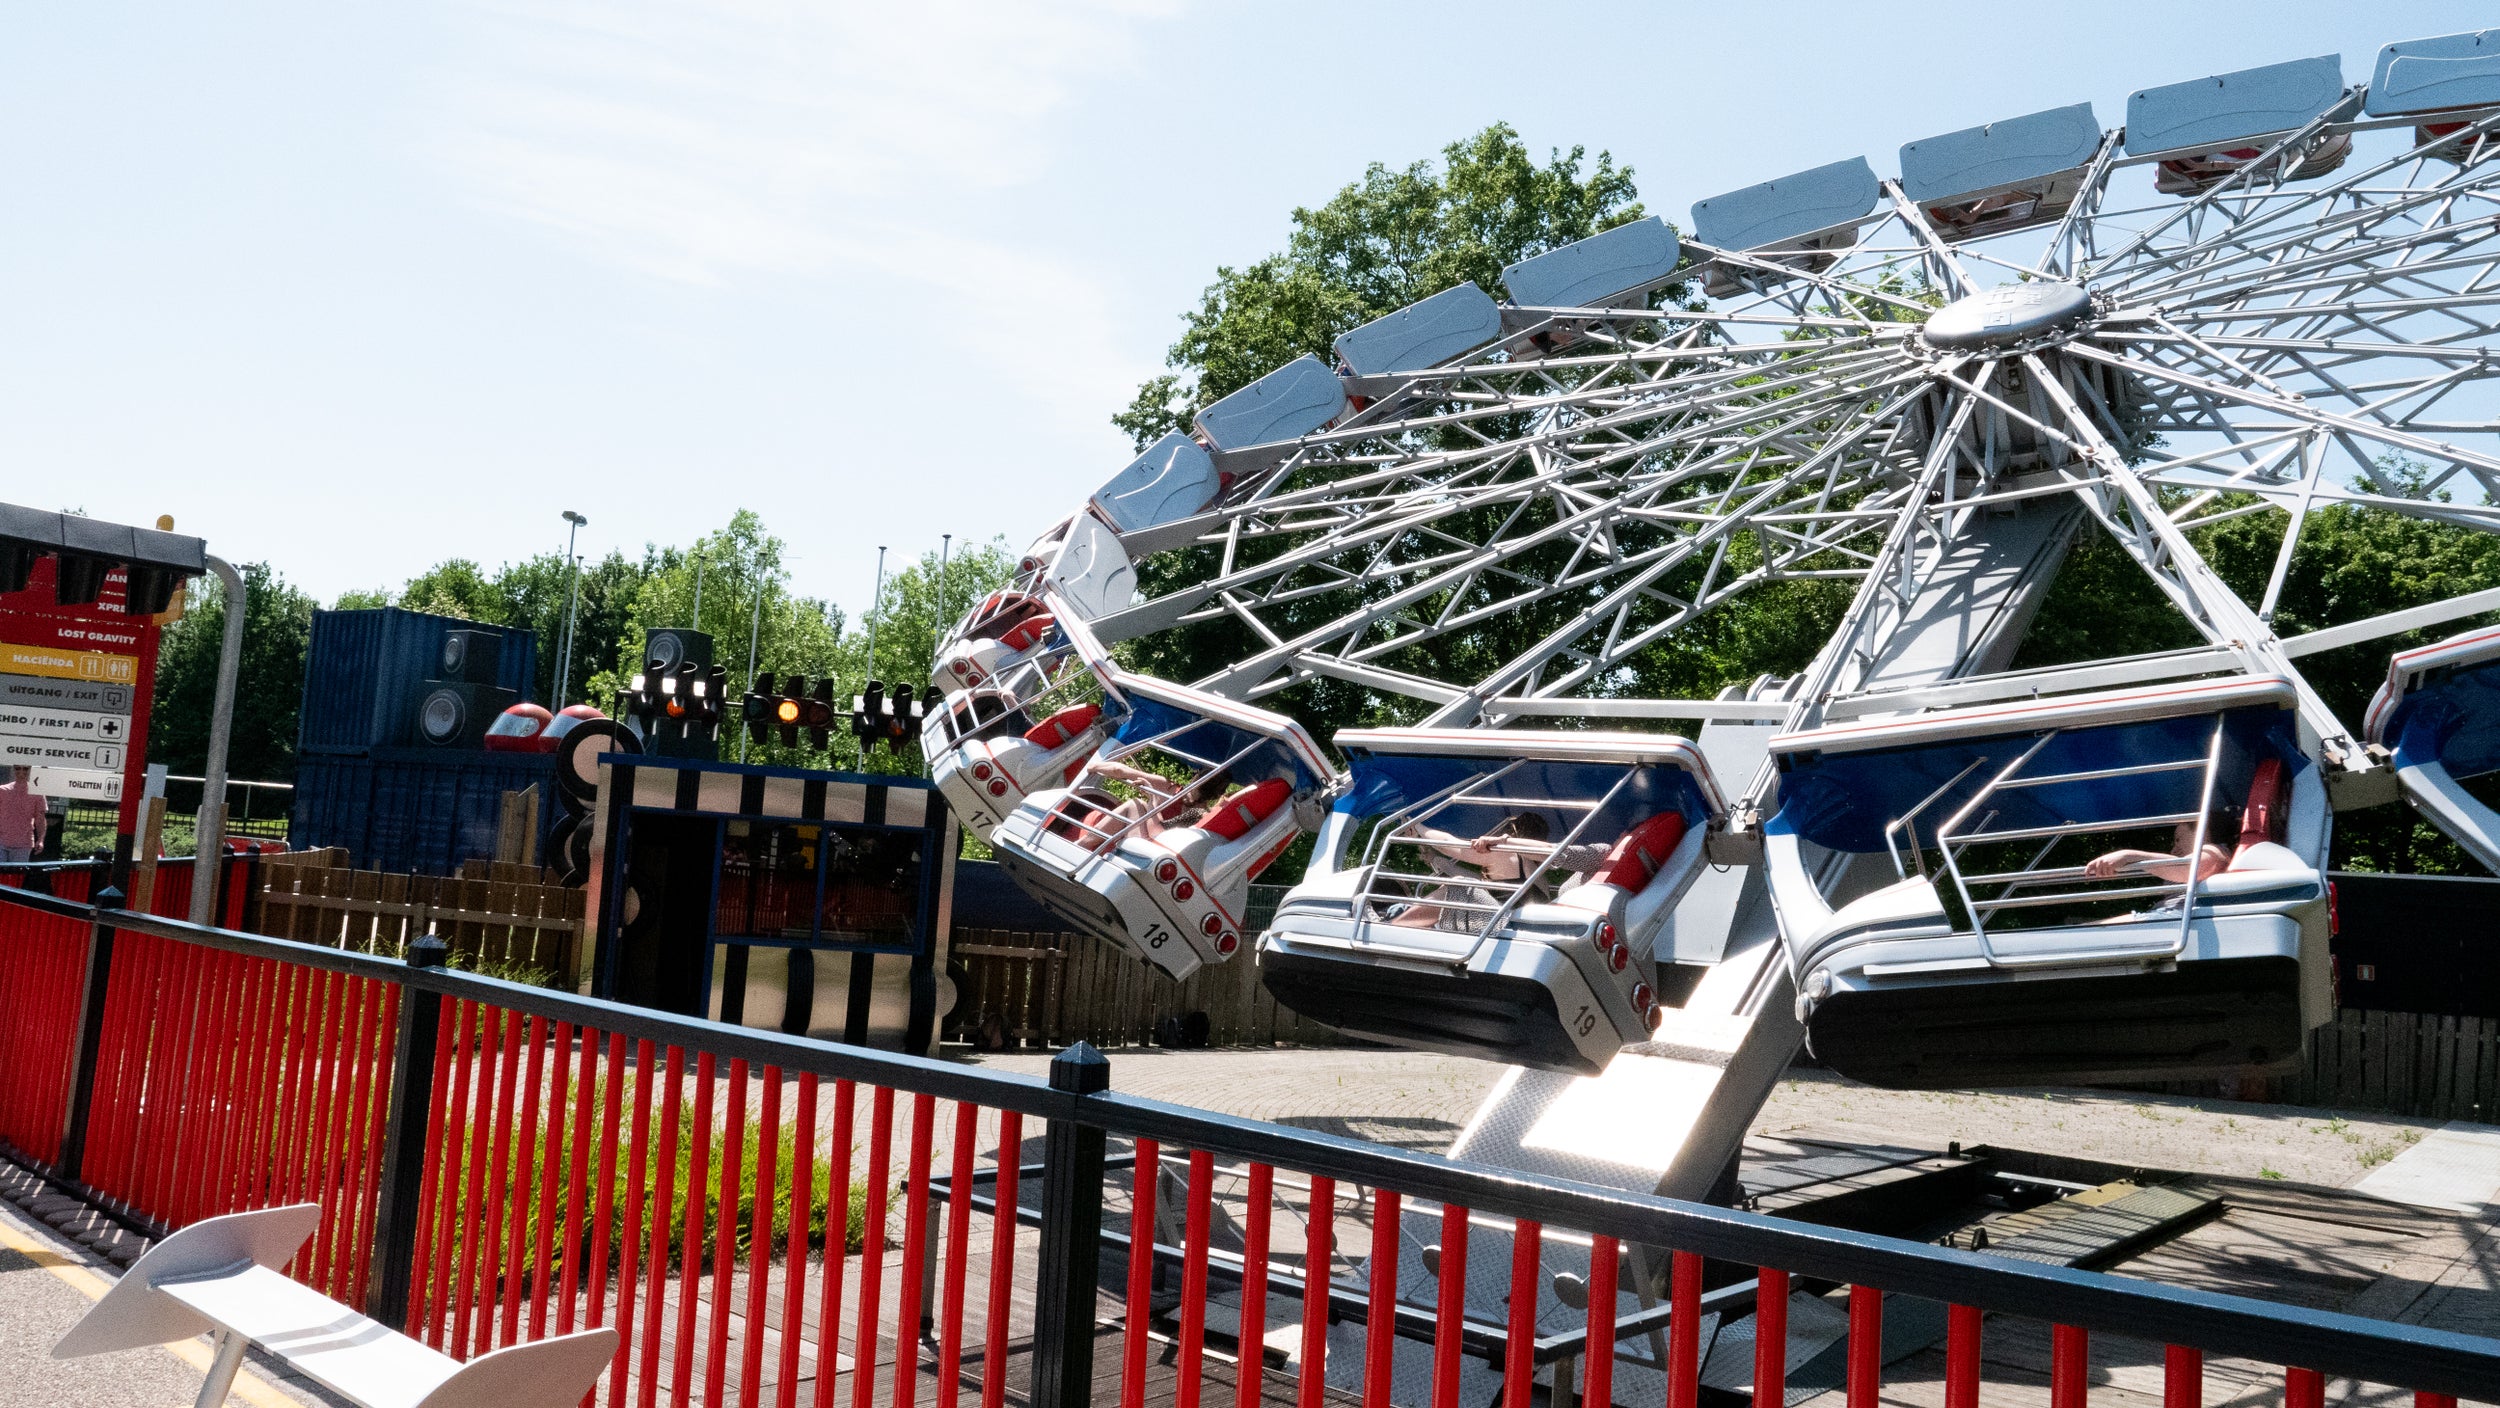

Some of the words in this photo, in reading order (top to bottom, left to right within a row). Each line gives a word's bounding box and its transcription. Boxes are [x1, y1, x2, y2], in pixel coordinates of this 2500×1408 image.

[58, 628, 85, 639] LOST
[6, 745, 42, 756] GUEST
[970, 810, 994, 829] 17
[1143, 923, 1170, 949] 18
[1573, 1005, 1596, 1037] 19
